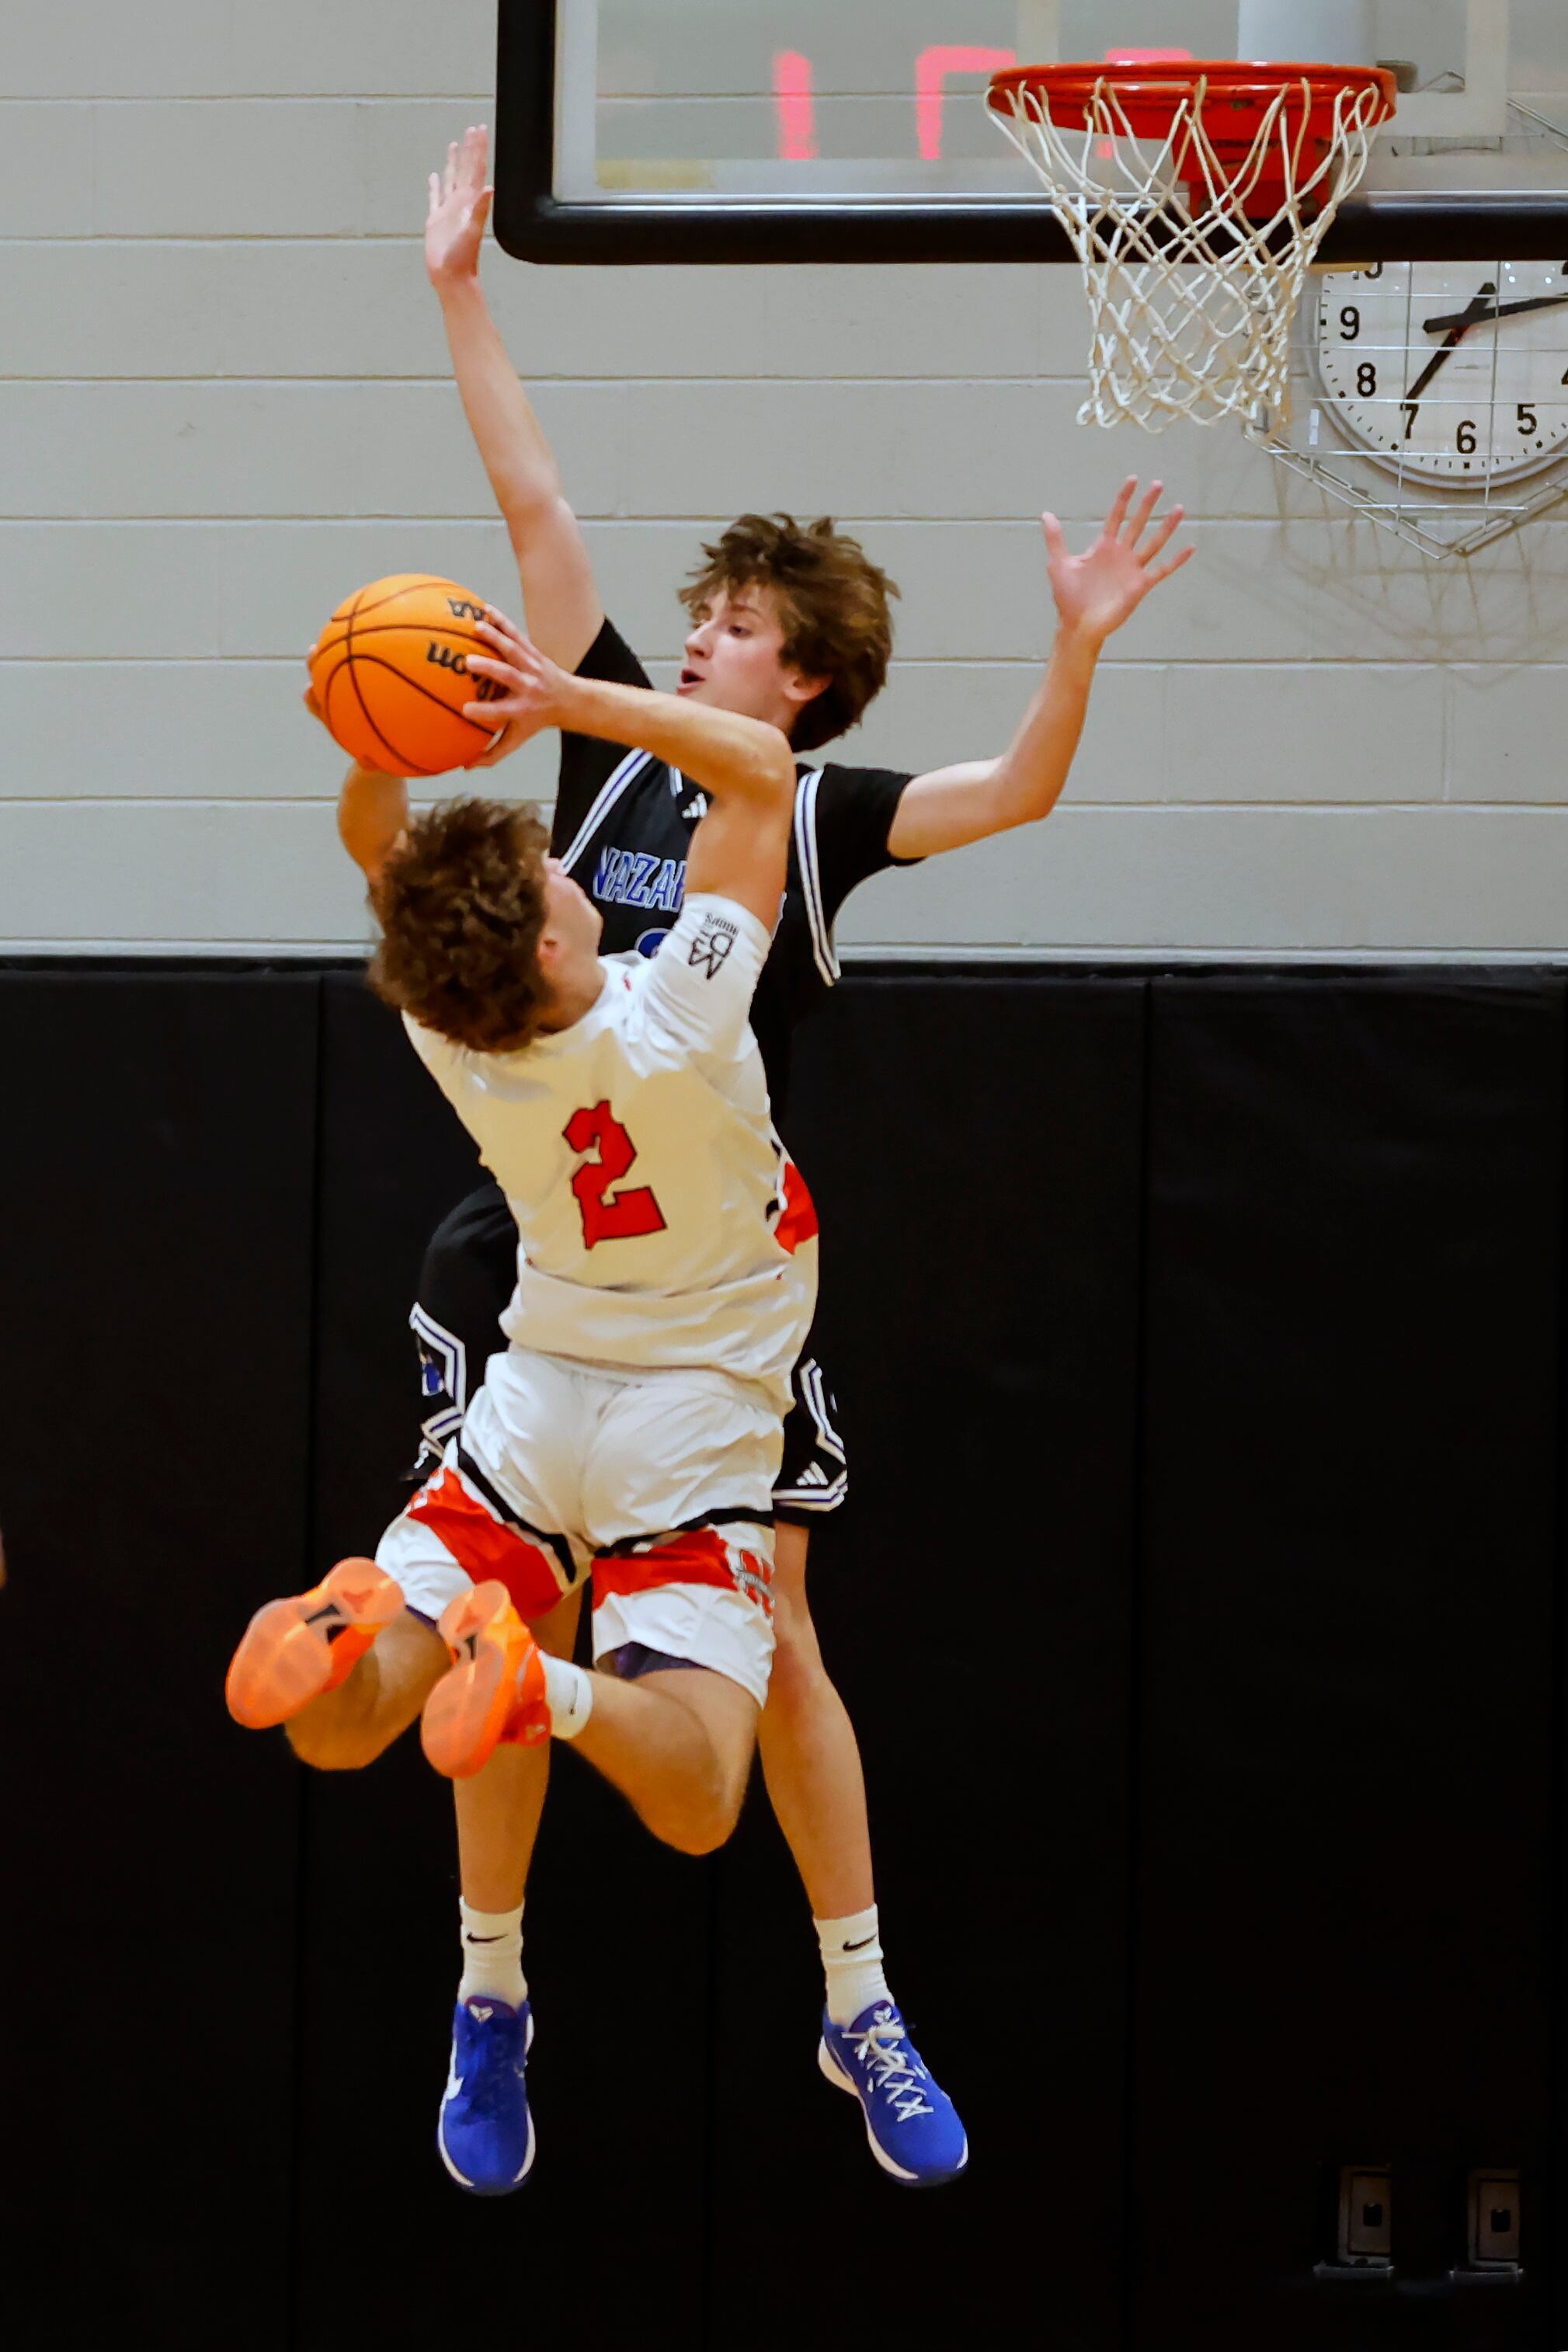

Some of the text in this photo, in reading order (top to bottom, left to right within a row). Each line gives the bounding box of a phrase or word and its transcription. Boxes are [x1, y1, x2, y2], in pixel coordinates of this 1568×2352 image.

[1340, 306, 1360, 341] 9
[1357, 362, 1376, 398] 8
[1399, 403, 1420, 440] 7
[1456, 420, 1477, 454] 6
[1517, 403, 1538, 436] 5
[562, 1099, 667, 1250] 2
